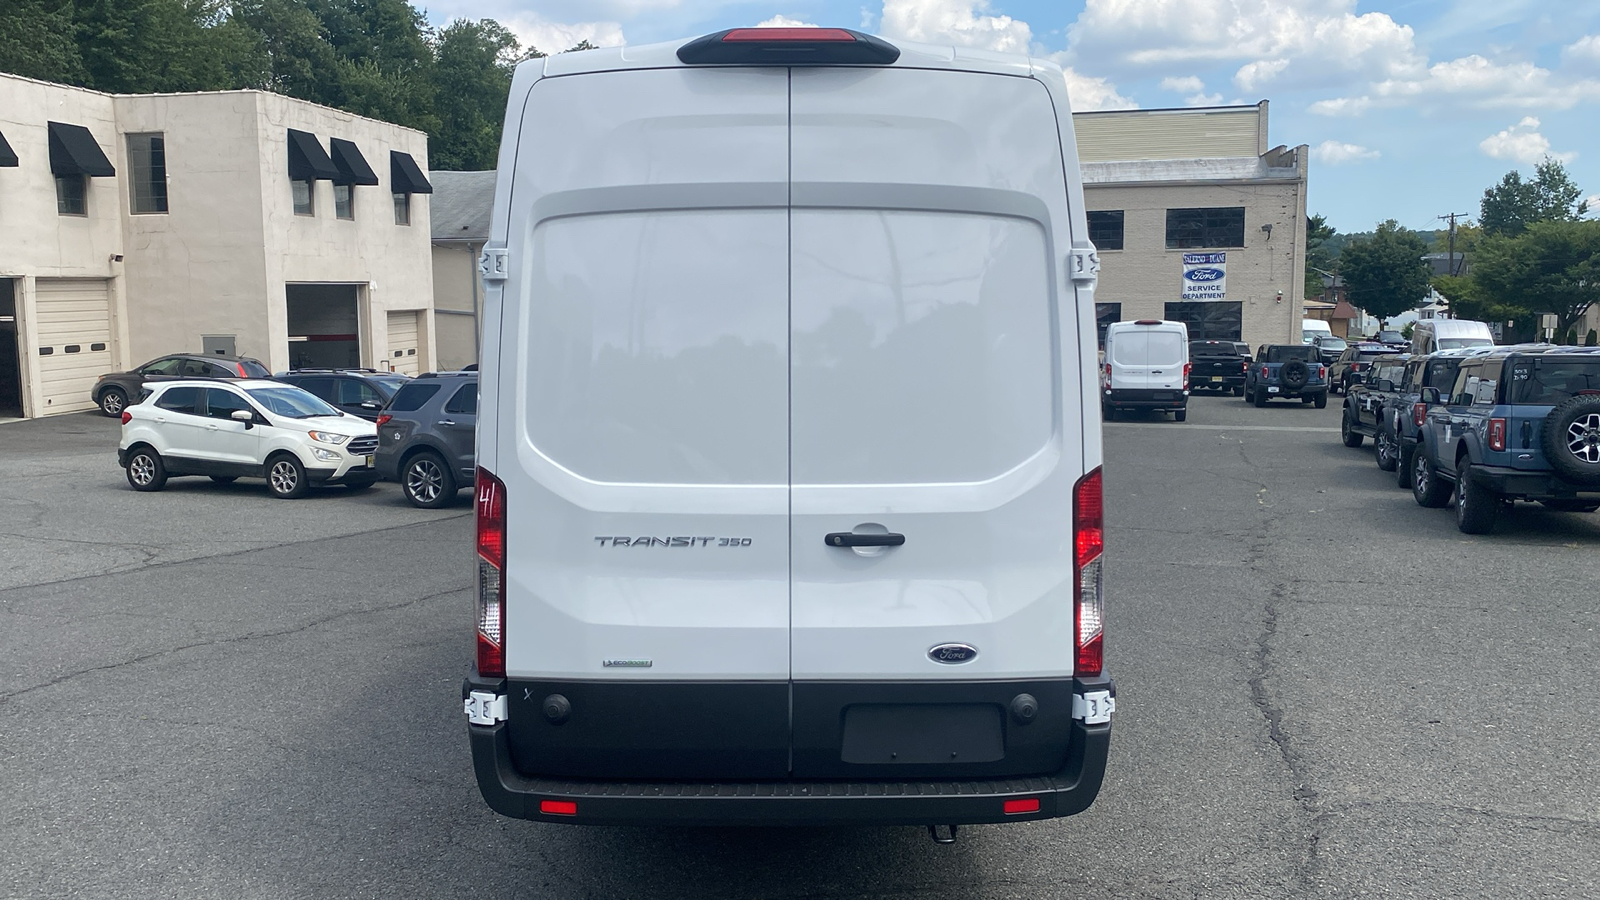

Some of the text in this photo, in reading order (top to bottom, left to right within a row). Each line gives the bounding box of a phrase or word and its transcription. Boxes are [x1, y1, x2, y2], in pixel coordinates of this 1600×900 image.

[1191, 269, 1218, 280] Ford
[594, 536, 753, 548] TRANSIT 350
[940, 647, 967, 660] Ford
